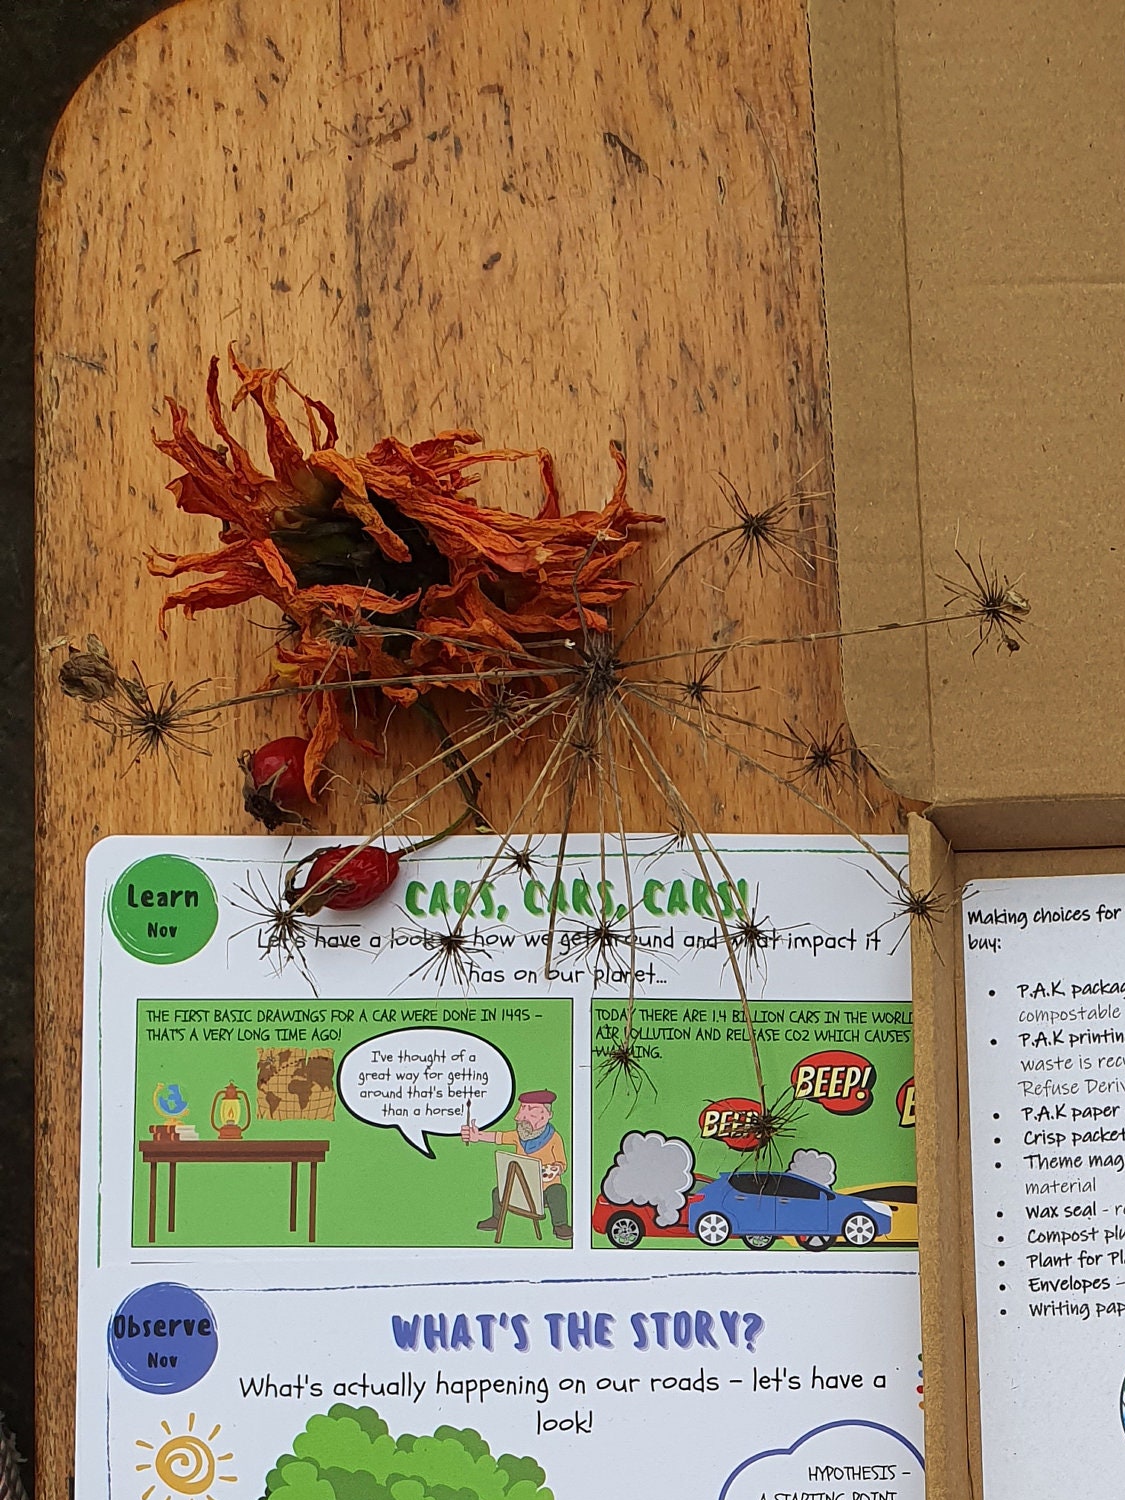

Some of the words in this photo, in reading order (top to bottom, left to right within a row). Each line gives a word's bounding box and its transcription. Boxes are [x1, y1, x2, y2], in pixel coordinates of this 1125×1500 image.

[127, 883, 199, 908] Learn
[404, 879, 511, 923] CARS,
[967, 908, 1028, 930] Making
[1032, 906, 1091, 924] choices
[1095, 903, 1122, 923] for
[147, 922, 178, 938] Nov
[967, 933, 1002, 954] buy:
[145, 1009, 170, 1023] THE
[174, 1009, 211, 1023] FIRST
[213, 1008, 253, 1023] BASIC
[257, 1008, 328, 1023] DRAWINGS
[330, 1008, 355, 1023] FOR
[358, 1008, 368, 1023] A
[372, 1008, 397, 1023] CAR
[400, 1008, 438, 1023] WERE
[442, 1007, 477, 1022] DONE
[480, 1007, 497, 1022] IN
[501, 1008, 531, 1022] 1495
[1018, 1003, 1122, 1025] compostable
[145, 1027, 186, 1042] THAT'S
[189, 1027, 199, 1042] A
[202, 1027, 235, 1042] VERY
[237, 1027, 271, 1042] LONG
[274, 1027, 307, 1042] TIME
[311, 1027, 342, 1042] AGO!
[370, 1050, 394, 1063] I've
[397, 1049, 447, 1064] thought
[450, 1048, 467, 1063] of
[468, 1054, 476, 1063] a
[357, 1067, 391, 1086] great
[395, 1072, 420, 1085] way
[423, 1065, 444, 1082] for
[447, 1067, 489, 1086] getting
[795, 1064, 871, 1101] BEEP!
[359, 1085, 403, 1099] around
[406, 1085, 444, 1099] that's
[447, 1085, 488, 1099] better
[381, 1102, 409, 1118] than
[413, 1108, 421, 1116] a
[425, 1102, 464, 1117] horse!
[1027, 1226, 1100, 1246] Compost
[112, 1313, 213, 1340] Observe
[391, 1312, 529, 1353] WHAT'S
[543, 1310, 615, 1351] THE
[630, 1309, 764, 1354] STORY?
[147, 1351, 178, 1369] Nov
[239, 1373, 323, 1399] What's
[333, 1371, 427, 1404] actually
[435, 1370, 549, 1404] happening
[558, 1378, 586, 1395] on
[596, 1377, 641, 1393] our
[650, 1367, 720, 1393] roads
[753, 1366, 801, 1392] let's
[811, 1365, 864, 1390] have
[873, 1375, 886, 1389] a
[537, 1410, 593, 1436] look!
